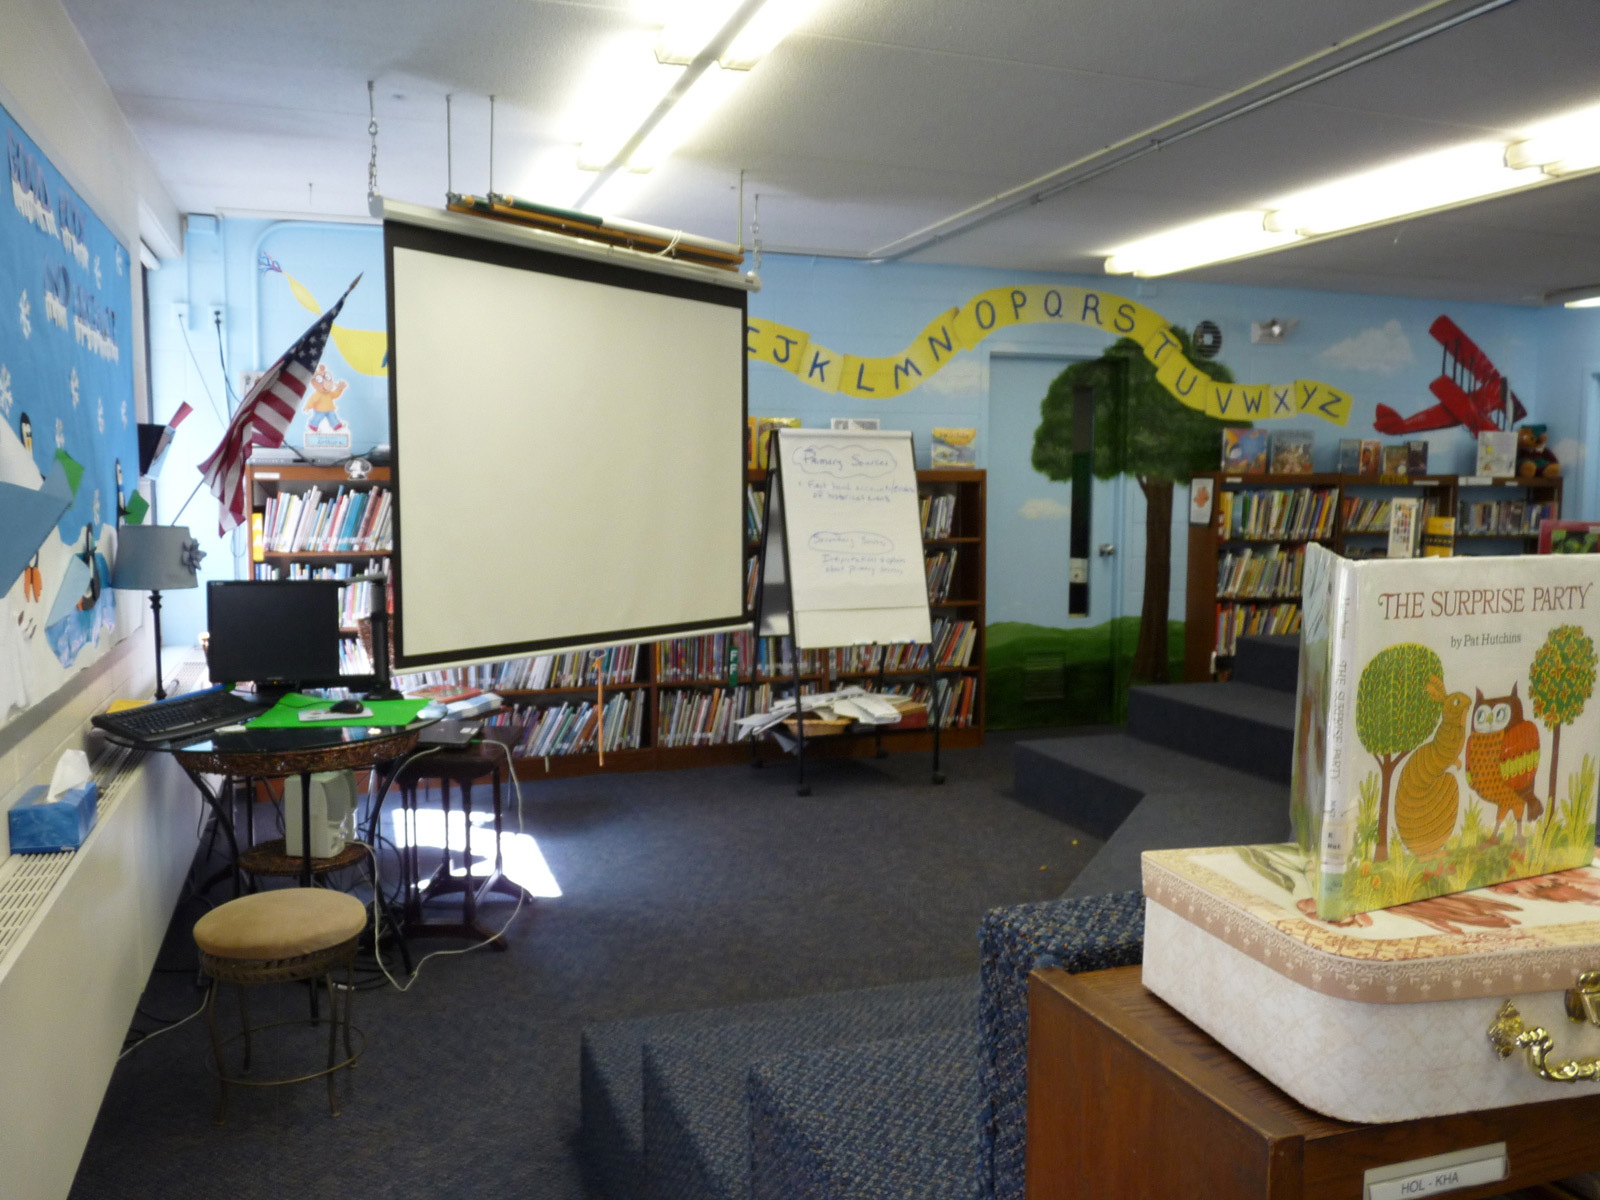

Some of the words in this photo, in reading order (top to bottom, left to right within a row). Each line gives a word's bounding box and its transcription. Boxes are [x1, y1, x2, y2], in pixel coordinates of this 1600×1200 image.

[774, 336, 798, 364] J
[809, 351, 830, 382] K
[857, 363, 874, 391] L
[895, 358, 922, 389] M
[929, 326, 953, 361] N
[975, 300, 996, 329] O
[1011, 290, 1027, 319] P
[1044, 290, 1063, 318] Q
[1082, 294, 1102, 325] R
[1114, 304, 1136, 332] S
[1154, 332, 1178, 359] T
[1176, 368, 1197, 396] U
[1217, 387, 1232, 413] V
[1243, 391, 1262, 413] W
[1274, 389, 1289, 413] X
[1302, 385, 1317, 409] Y
[1319, 391, 1342, 417] Z
[1378, 592, 1425, 620] THE
[1431, 588, 1525, 617] SURPRISE
[1531, 582, 1594, 611] PARTY
[1451, 635, 1462, 649] by
[1463, 634, 1479, 647] Pat
[1481, 632, 1522, 646] Hutchins
[1401, 1180, 1425, 1195] HOL
[1435, 1171, 1459, 1187] KHA
